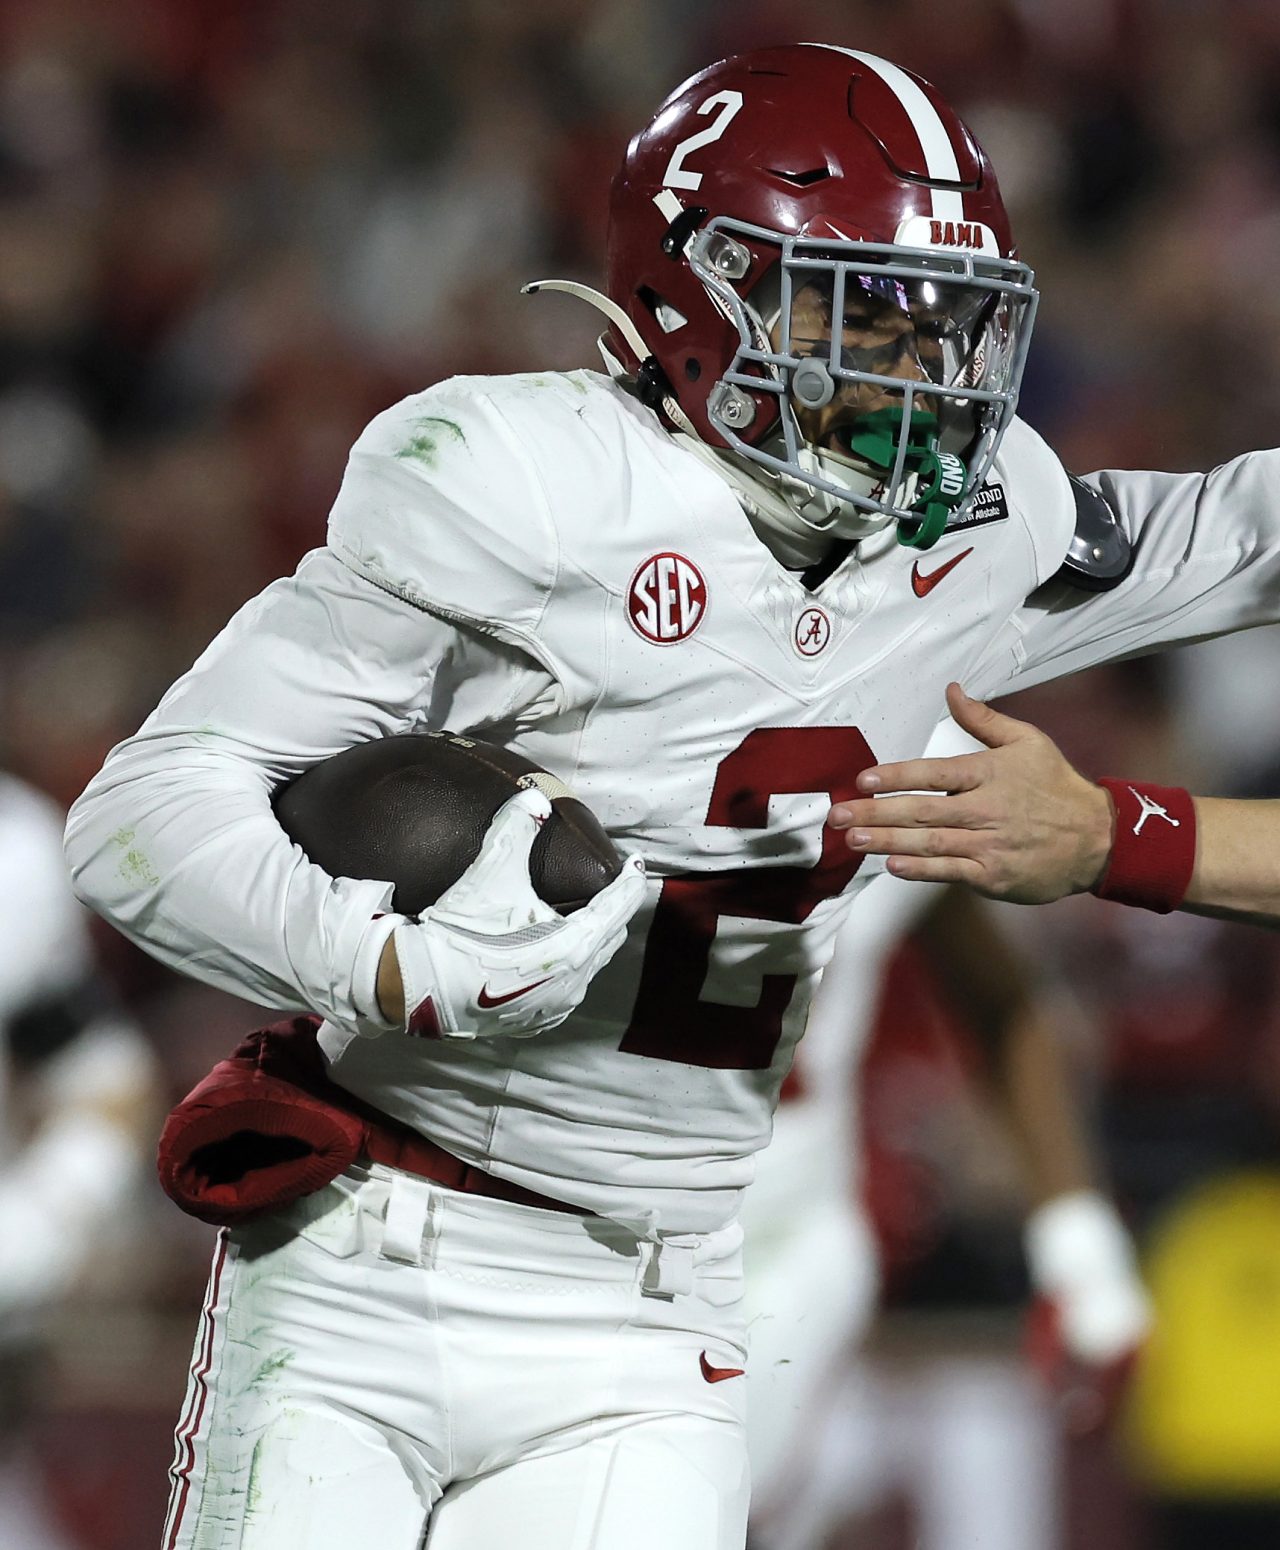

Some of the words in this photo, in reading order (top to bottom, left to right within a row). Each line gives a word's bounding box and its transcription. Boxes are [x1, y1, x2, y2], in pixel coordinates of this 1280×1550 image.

[661, 89, 744, 191] 2
[930, 220, 984, 249] BAMA
[633, 557, 701, 638] SEC
[799, 614, 822, 646] A
[618, 725, 879, 1070] 2
